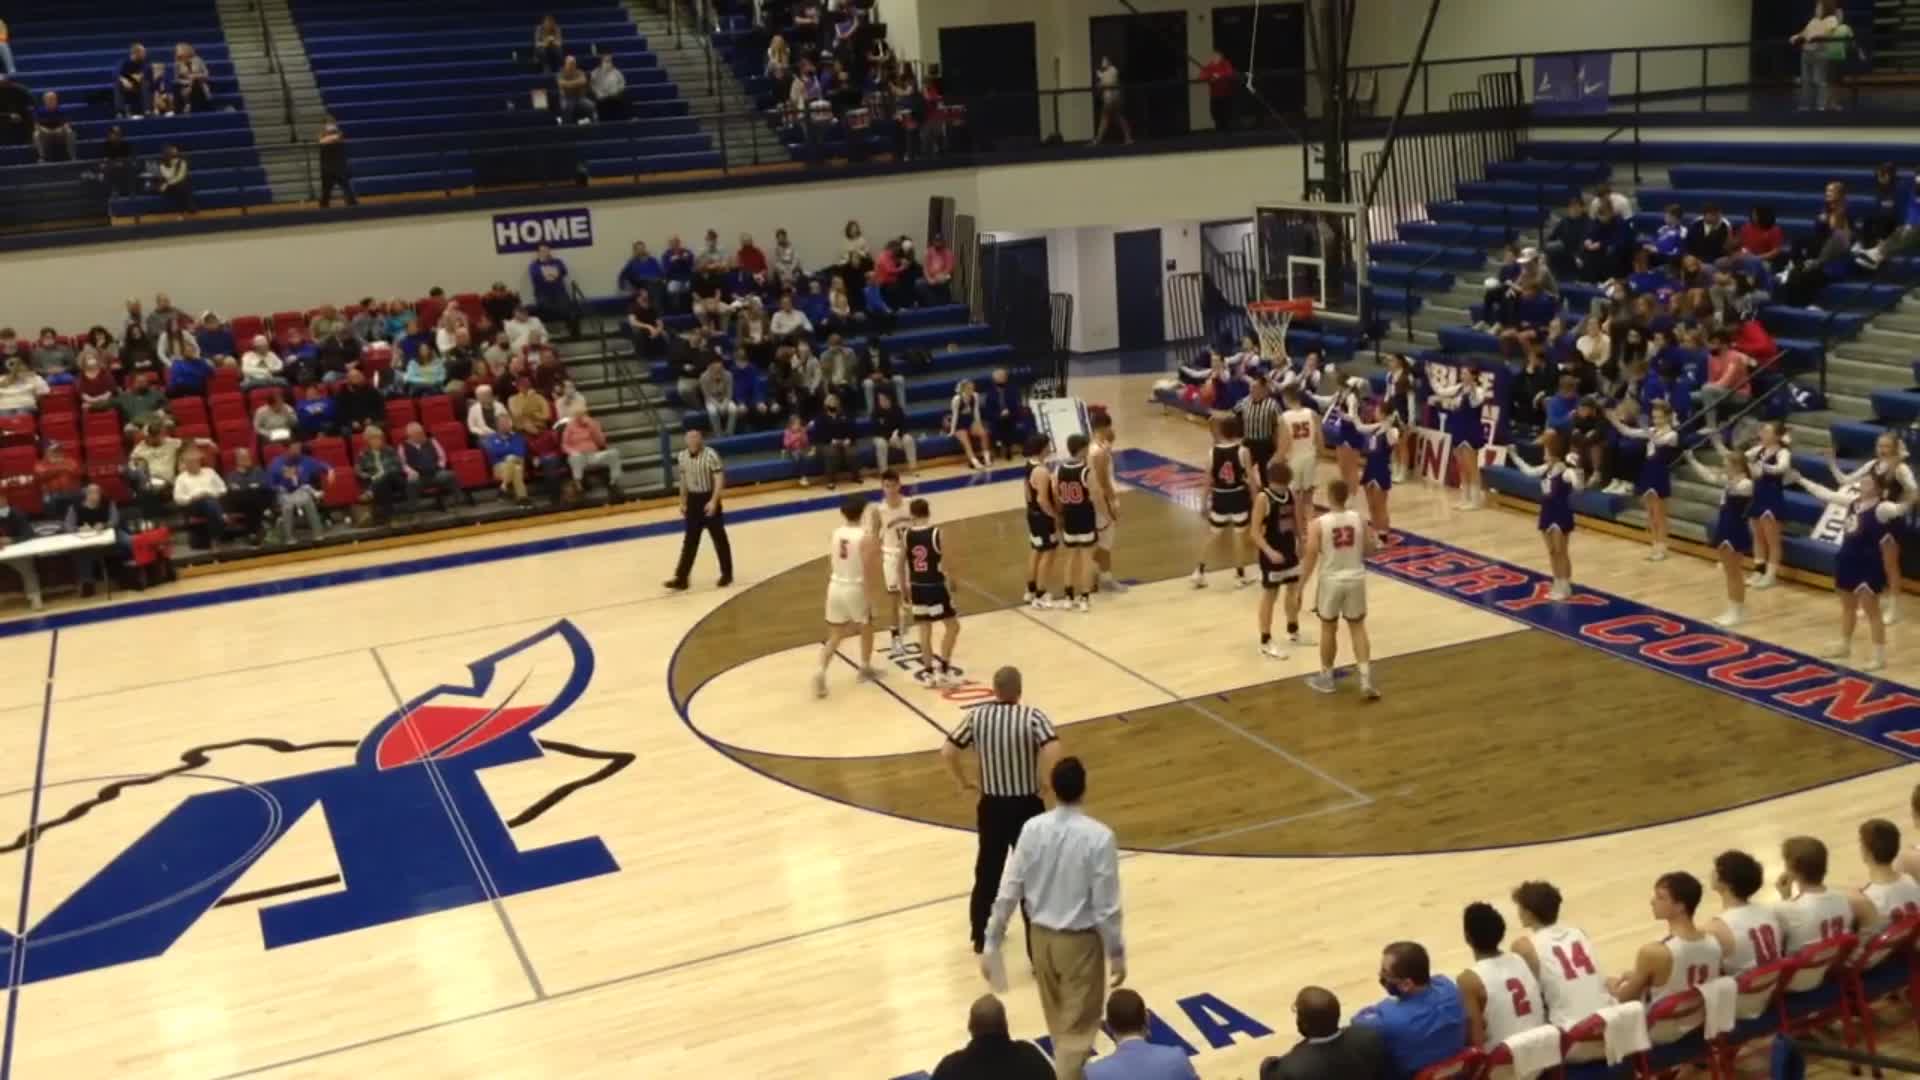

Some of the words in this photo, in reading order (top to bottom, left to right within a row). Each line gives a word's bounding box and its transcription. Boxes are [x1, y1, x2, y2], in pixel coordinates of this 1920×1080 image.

[495, 215, 590, 246] HOME
[1219, 461, 1235, 484] 4
[1059, 481, 1083, 504] 10
[1331, 526, 1355, 548] 23
[911, 545, 929, 572] 2
[1579, 613, 1920, 747] COUN
[1551, 940, 1597, 982] 14
[1505, 976, 1533, 1018] 2
